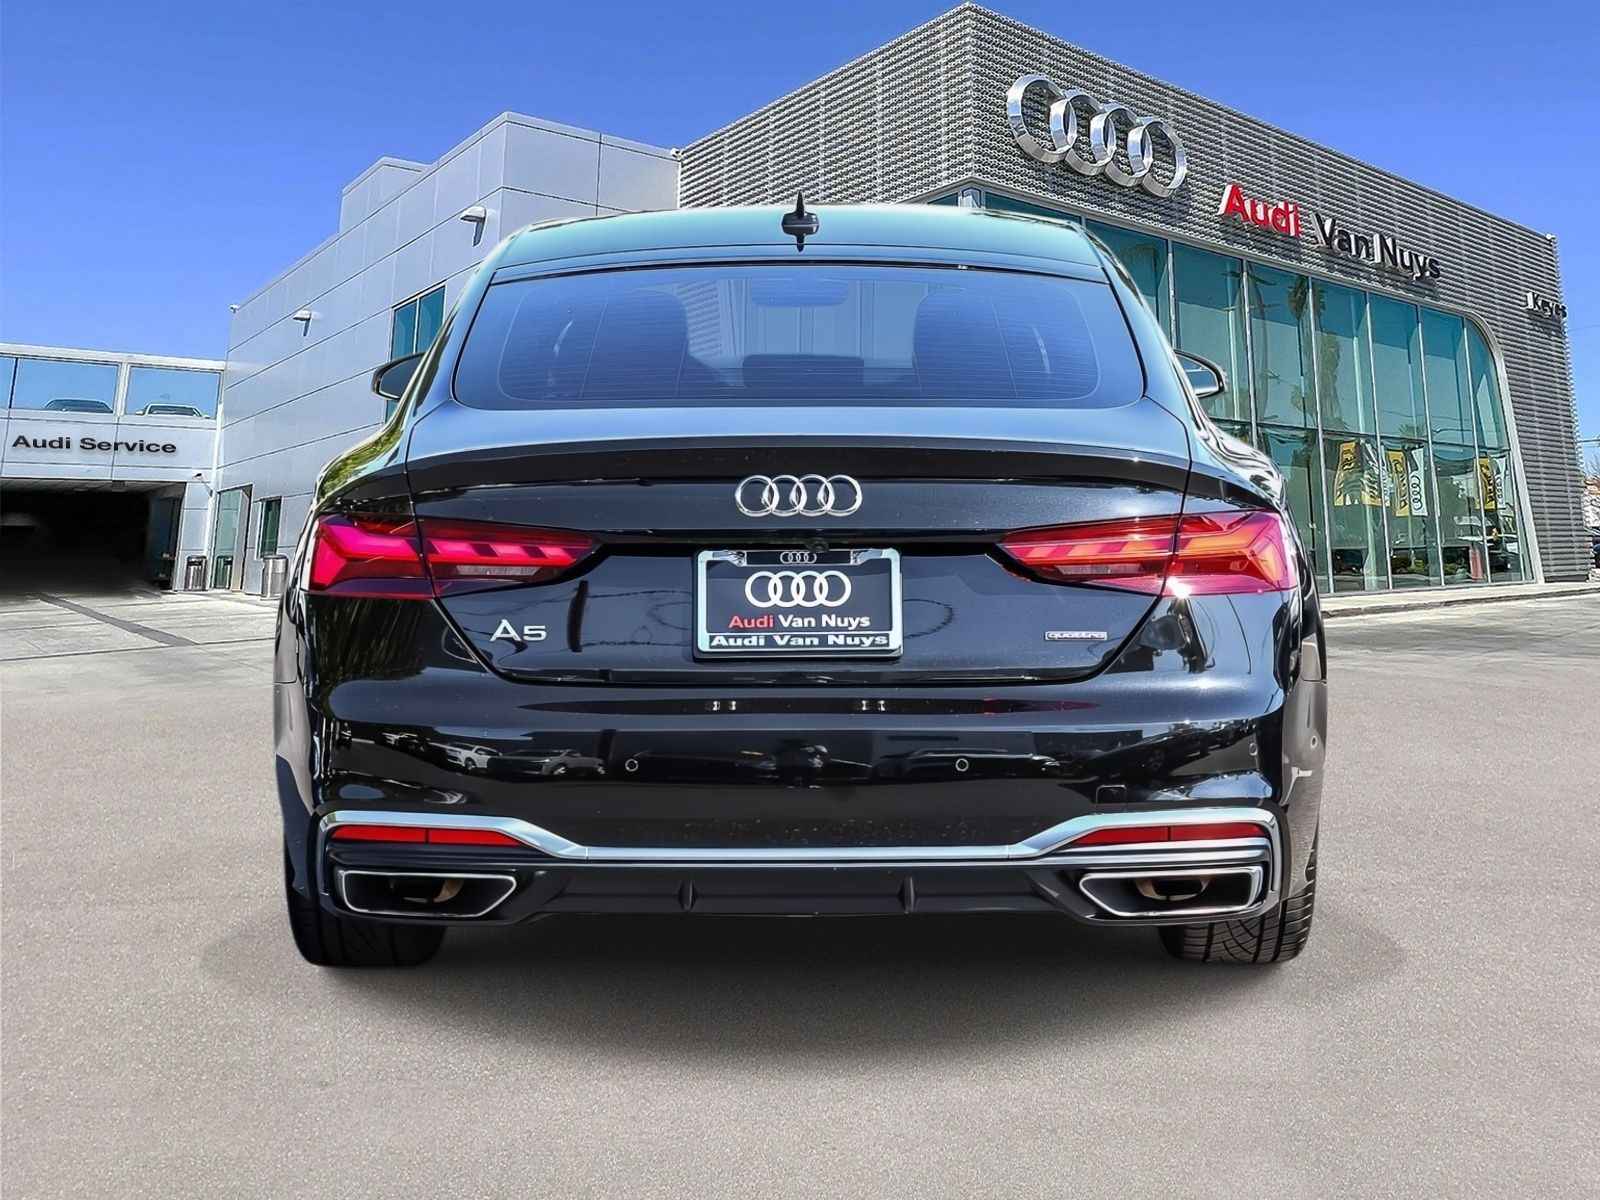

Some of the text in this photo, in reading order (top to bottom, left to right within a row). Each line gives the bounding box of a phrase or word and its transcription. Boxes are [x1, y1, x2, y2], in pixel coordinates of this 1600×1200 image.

[1217, 183, 1441, 280] Audi Van Nuys
[1526, 292, 1568, 318] Keyes
[12, 435, 177, 454] Audi Service
[489, 618, 548, 642] A5
[728, 614, 871, 631] Audi Van Nuys
[711, 634, 889, 648] Audi Van Nuys
